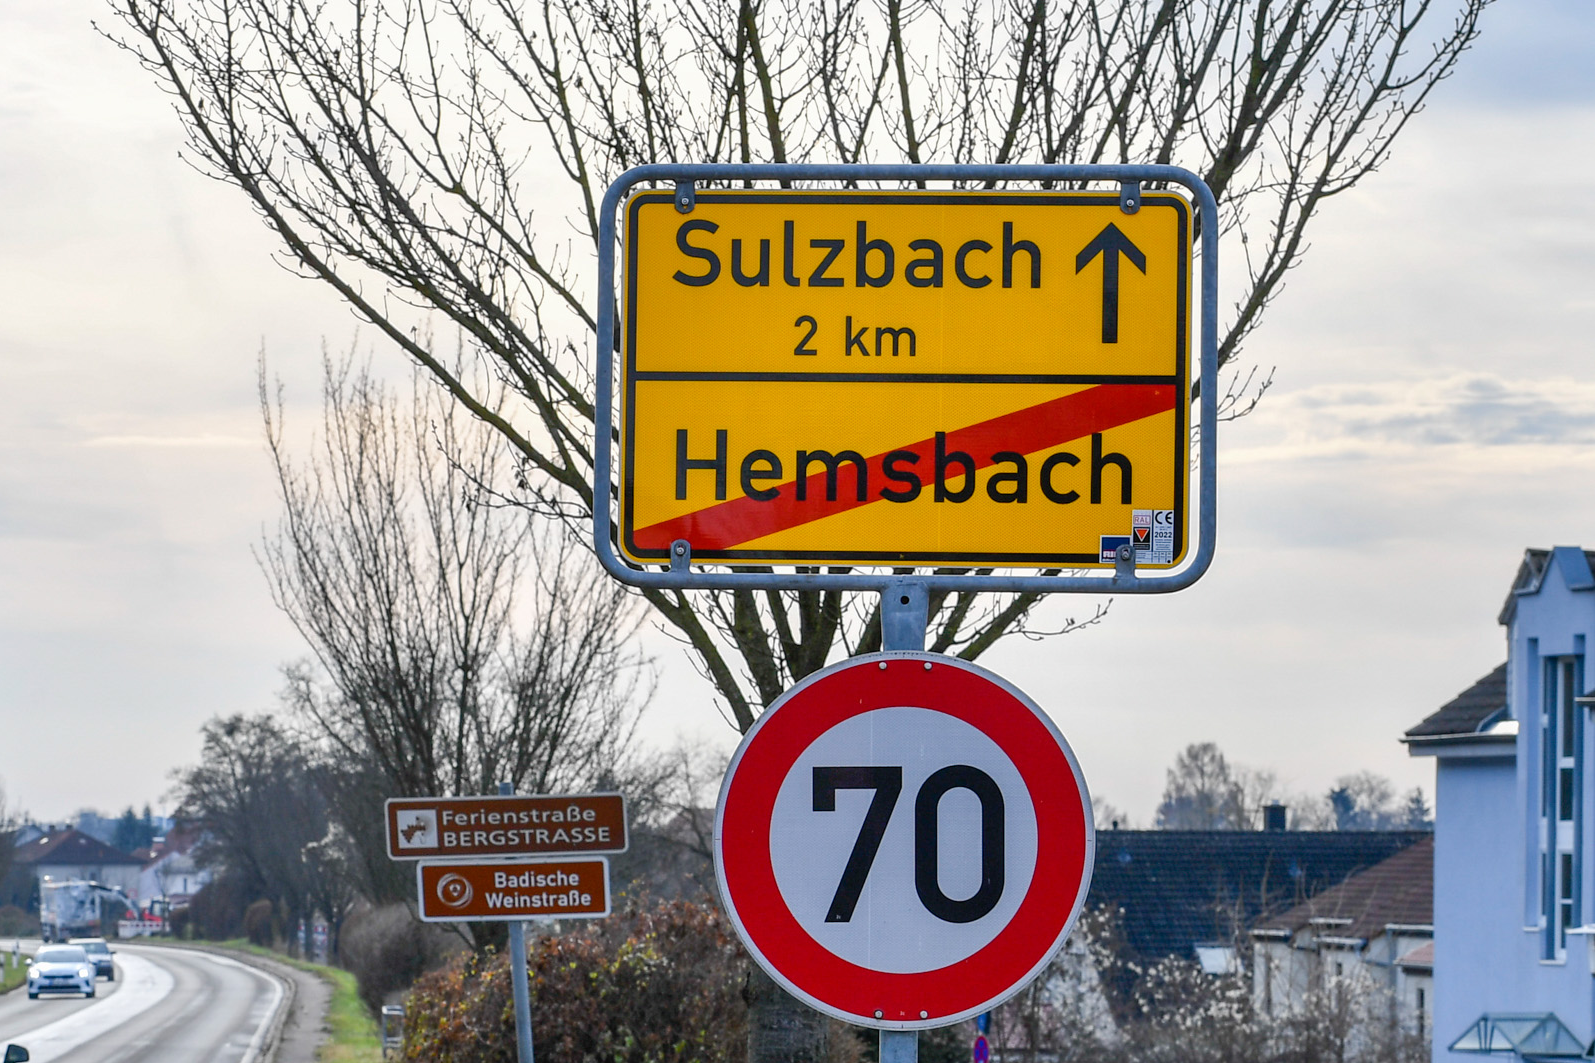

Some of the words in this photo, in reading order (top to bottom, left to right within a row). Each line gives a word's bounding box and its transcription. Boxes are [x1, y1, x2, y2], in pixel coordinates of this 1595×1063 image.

[672, 219, 1041, 289] Sulzbach
[793, 315, 818, 356] 2
[845, 315, 917, 357] km
[675, 428, 1133, 505] Hemsbach
[1154, 531, 1172, 539] 2022
[441, 805, 596, 826] Ferienstraße
[443, 826, 610, 848] BERGSTRASSE
[812, 764, 1005, 924] 70
[494, 869, 580, 889] Badische
[485, 889, 592, 909] Weinstraße
